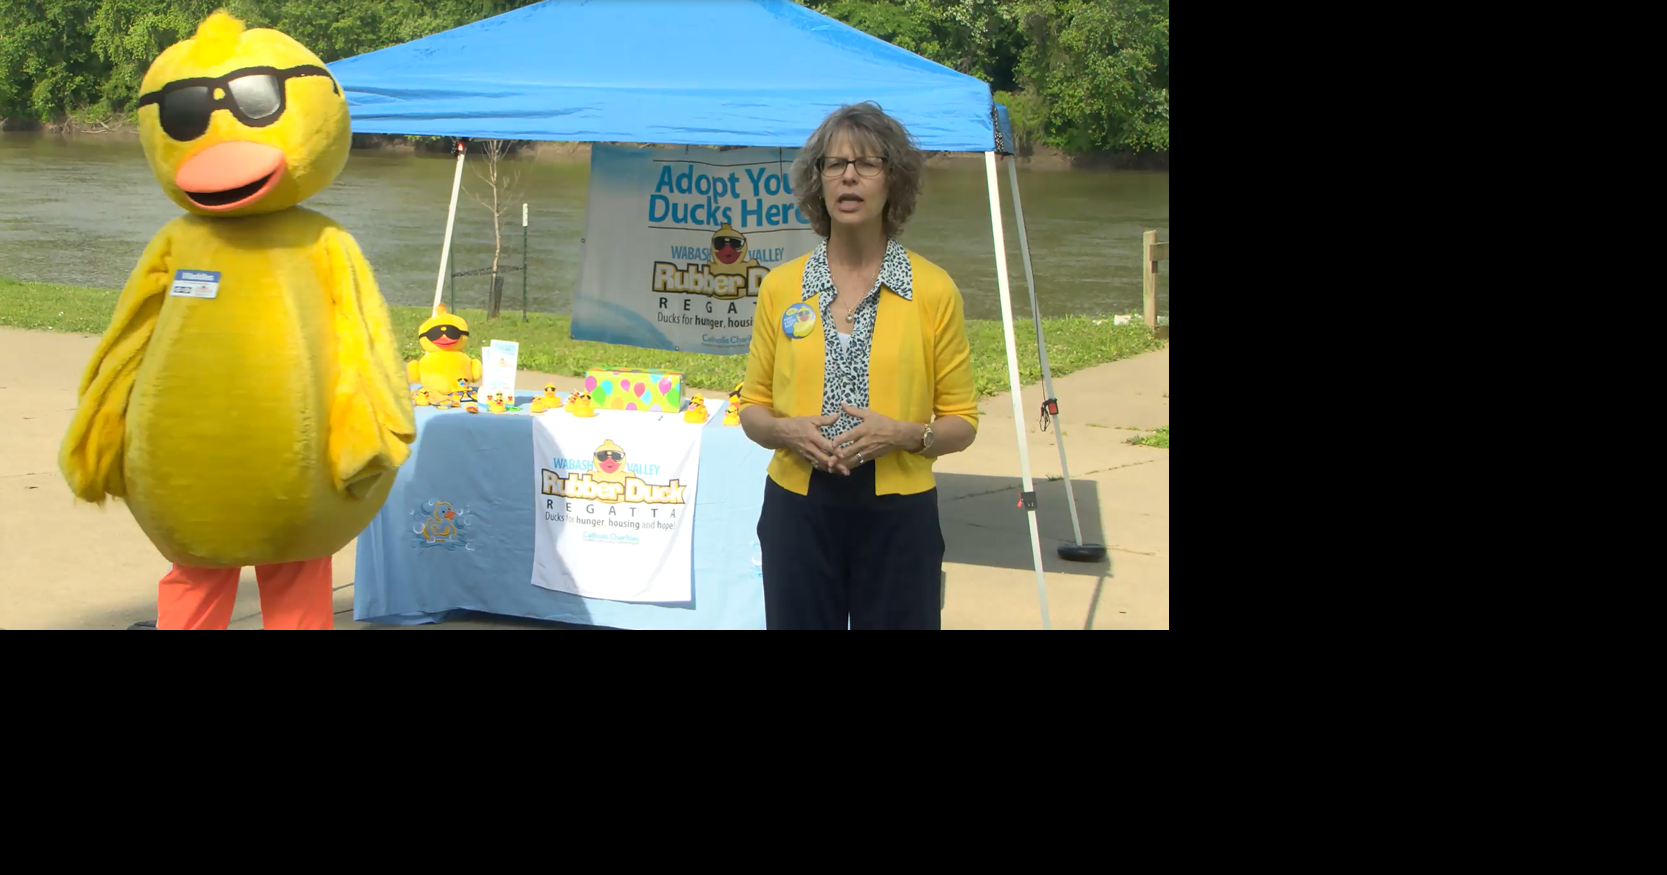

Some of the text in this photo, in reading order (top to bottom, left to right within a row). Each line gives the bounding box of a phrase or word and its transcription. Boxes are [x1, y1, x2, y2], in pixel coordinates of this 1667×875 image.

[655, 165, 794, 204] Adopt You
[648, 194, 732, 226] Ducks
[672, 246, 784, 262] WABASH VALLEY
[652, 261, 746, 297] Rubber
[657, 312, 753, 329] Ducks for hunger, housi
[553, 457, 660, 476] WABASH VALLEY
[541, 468, 687, 504] Rubber Duck
[546, 499, 677, 518] REGATTA
[545, 511, 565, 522] Ducks
[608, 518, 640, 530] housing
[641, 521, 656, 529] and
